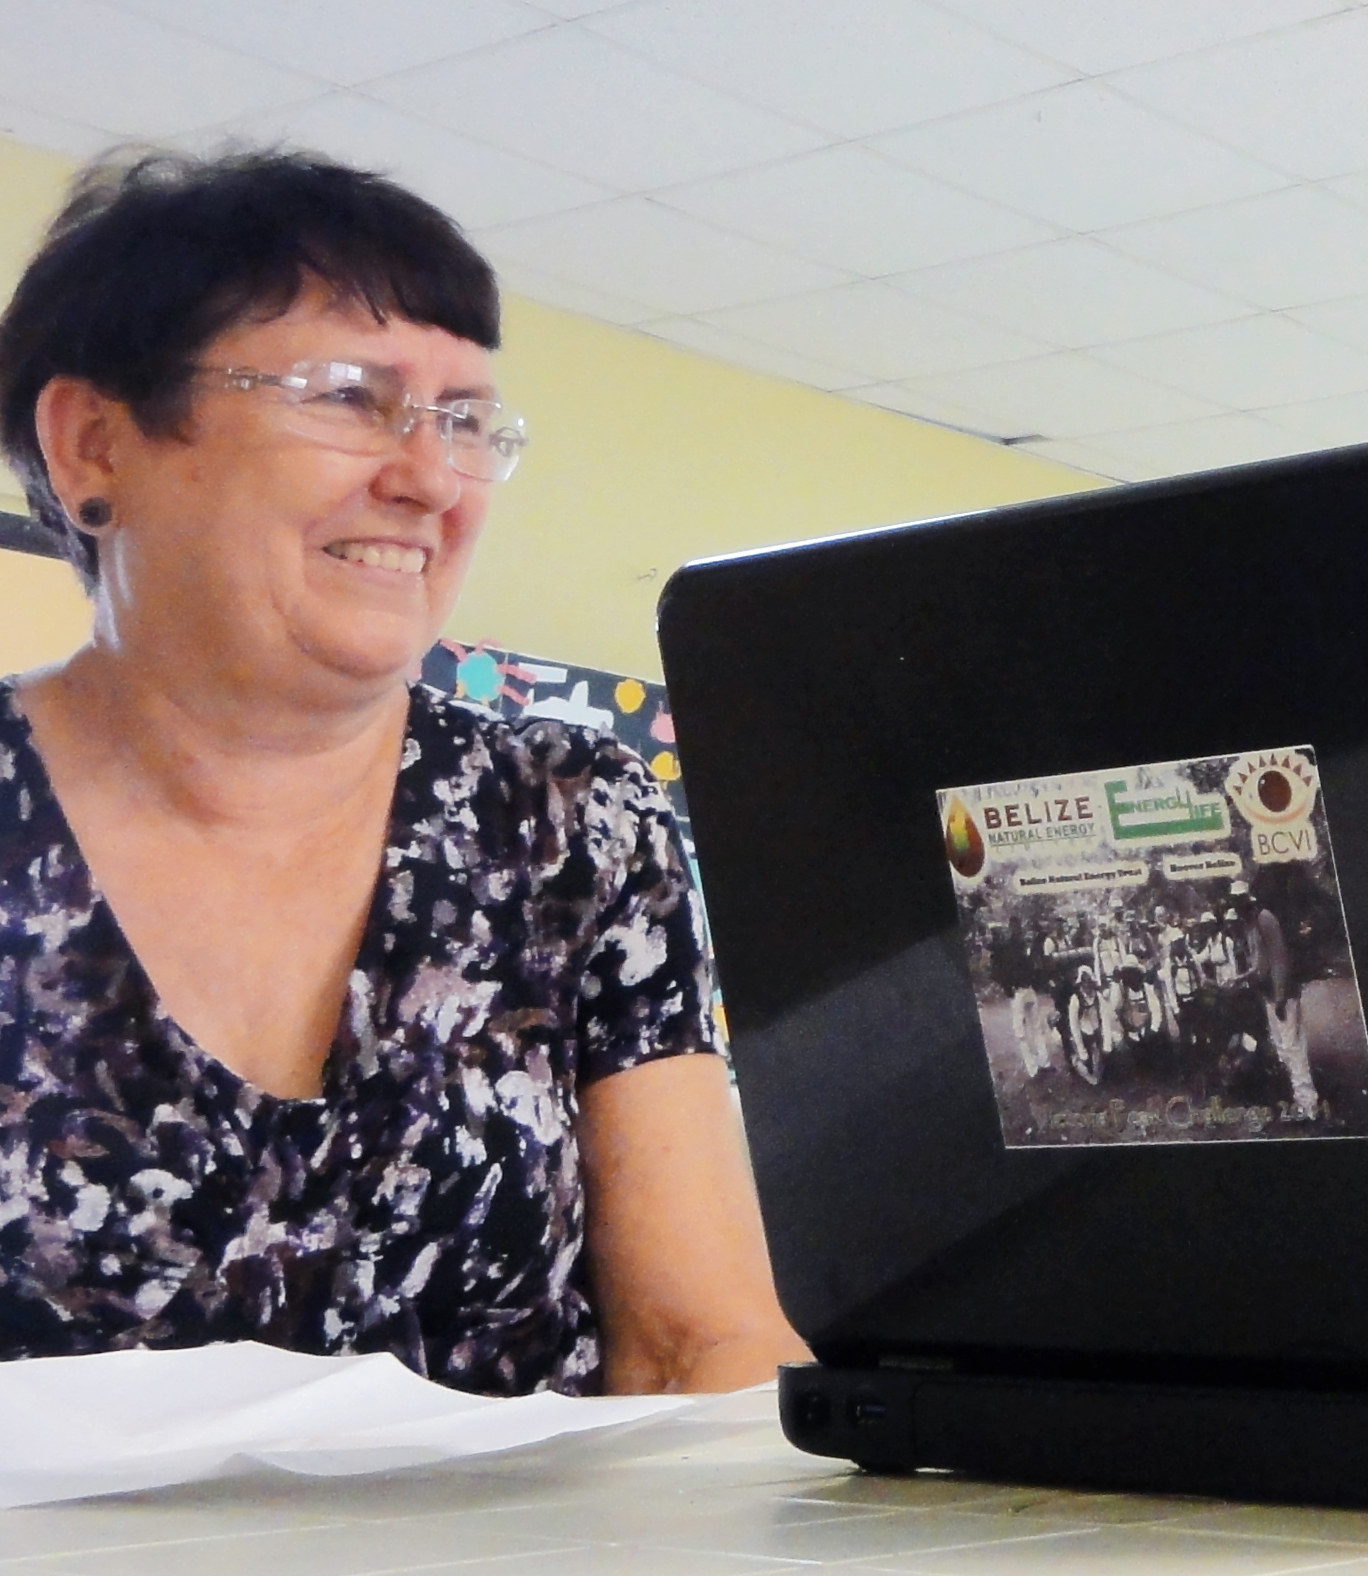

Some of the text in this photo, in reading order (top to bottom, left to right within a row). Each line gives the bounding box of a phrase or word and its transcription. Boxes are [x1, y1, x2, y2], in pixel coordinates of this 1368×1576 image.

[983, 796, 1094, 829] BELIZE
[988, 823, 1095, 844] NATURAL ENERGY
[1257, 829, 1312, 855] BCVI
[1084, 870, 1116, 881] Energy
